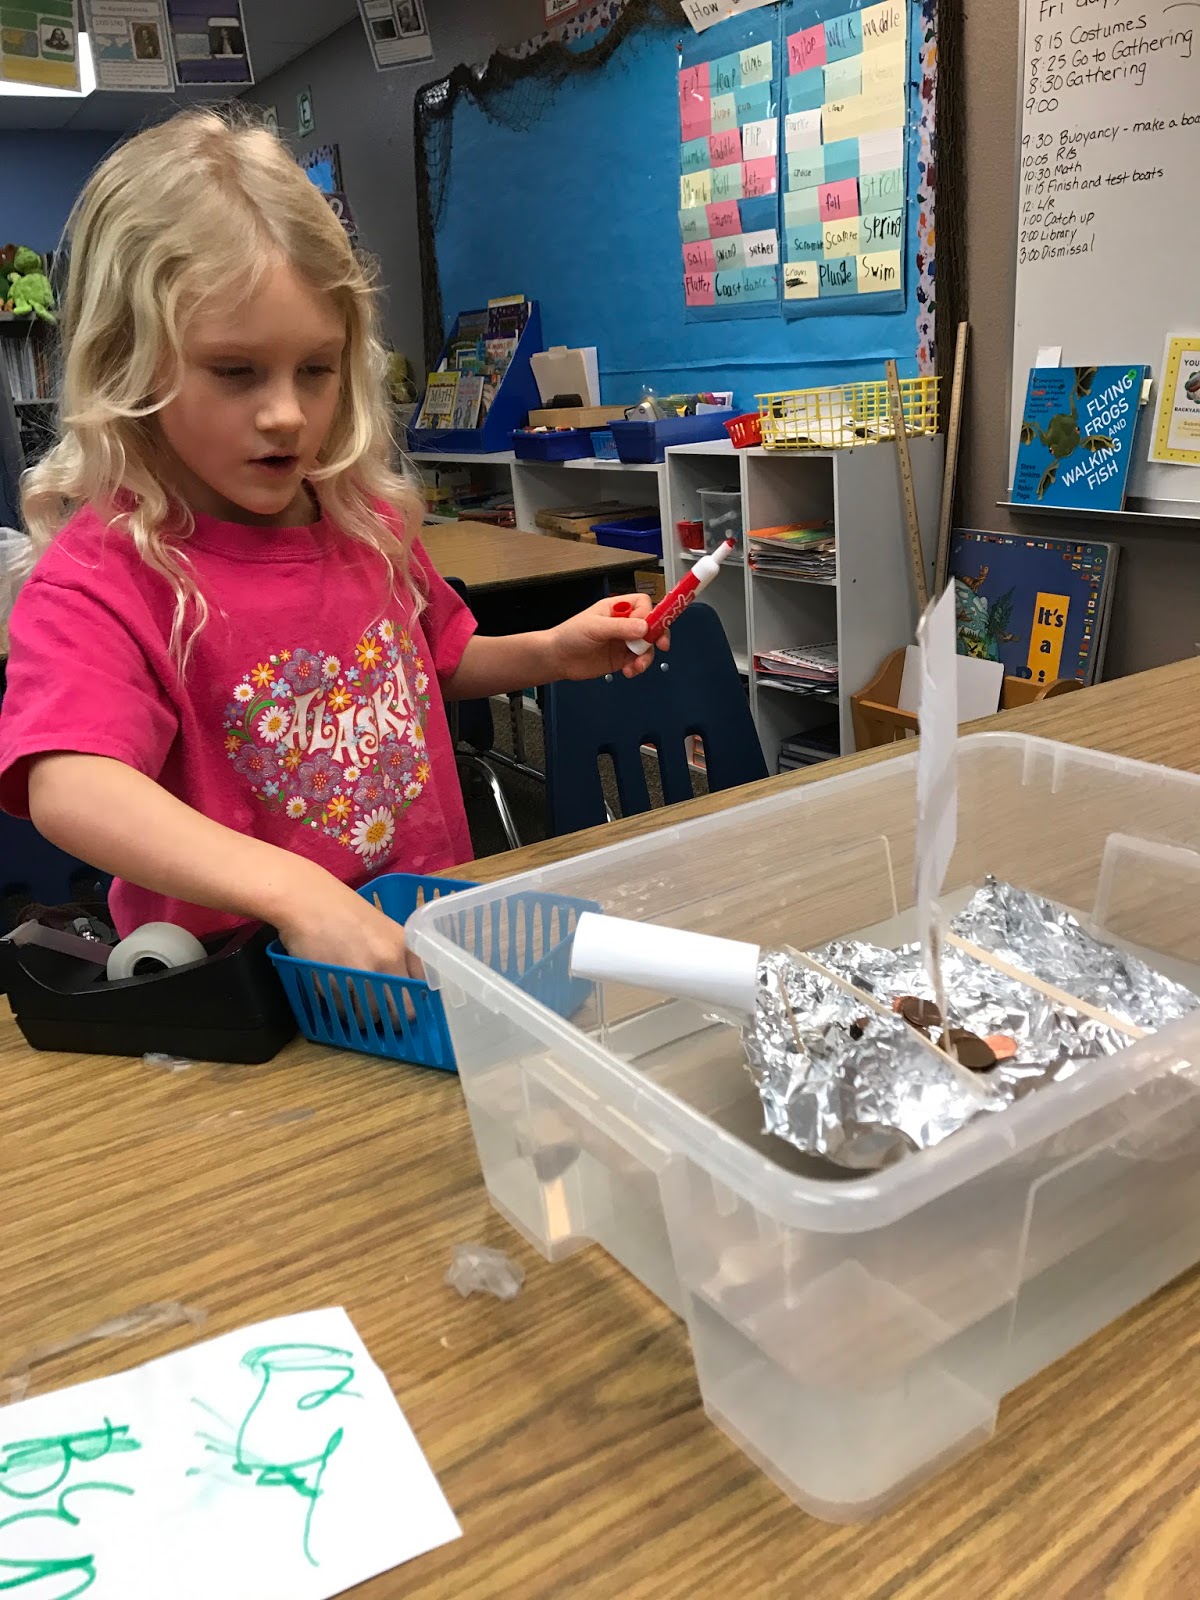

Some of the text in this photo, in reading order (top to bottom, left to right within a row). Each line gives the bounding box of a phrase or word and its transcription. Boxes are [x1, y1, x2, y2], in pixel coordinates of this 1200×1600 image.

[690, 2, 719, 20] How
[1070, 14, 1147, 44] Costumes
[1030, 29, 1193, 76] 8:25 Go to Gathering
[1029, 62, 1146, 94] 8:30 Gathering
[1025, 98, 1059, 115] 9:00
[1022, 134, 1053, 149] 9:30
[1059, 126, 1120, 147] Buoyancy
[1133, 118, 1165, 133] make
[1168, 119, 1178, 127] a
[1022, 154, 1049, 168] 10:05
[1024, 161, 1082, 181] 10:30 Math
[1025, 167, 1164, 195] 11:15 Finish and test boats
[1044, 211, 1076, 227] Catch
[1080, 211, 1095, 225] up
[1019, 233, 1095, 264] 3:00 Dismissal
[1021, 228, 1077, 244] 2:00 Library
[862, 256, 895, 281] Swim
[715, 273, 741, 297] Coast
[1086, 375, 1133, 417] FLYING
[1084, 398, 1129, 437] FROGS
[1108, 418, 1127, 437] AND
[1061, 438, 1122, 487] WALKING
[1087, 460, 1119, 491] FISH
[1037, 606, 1064, 628] It's
[1039, 639, 1052, 654] a
[281, 653, 415, 769] ALASKA
